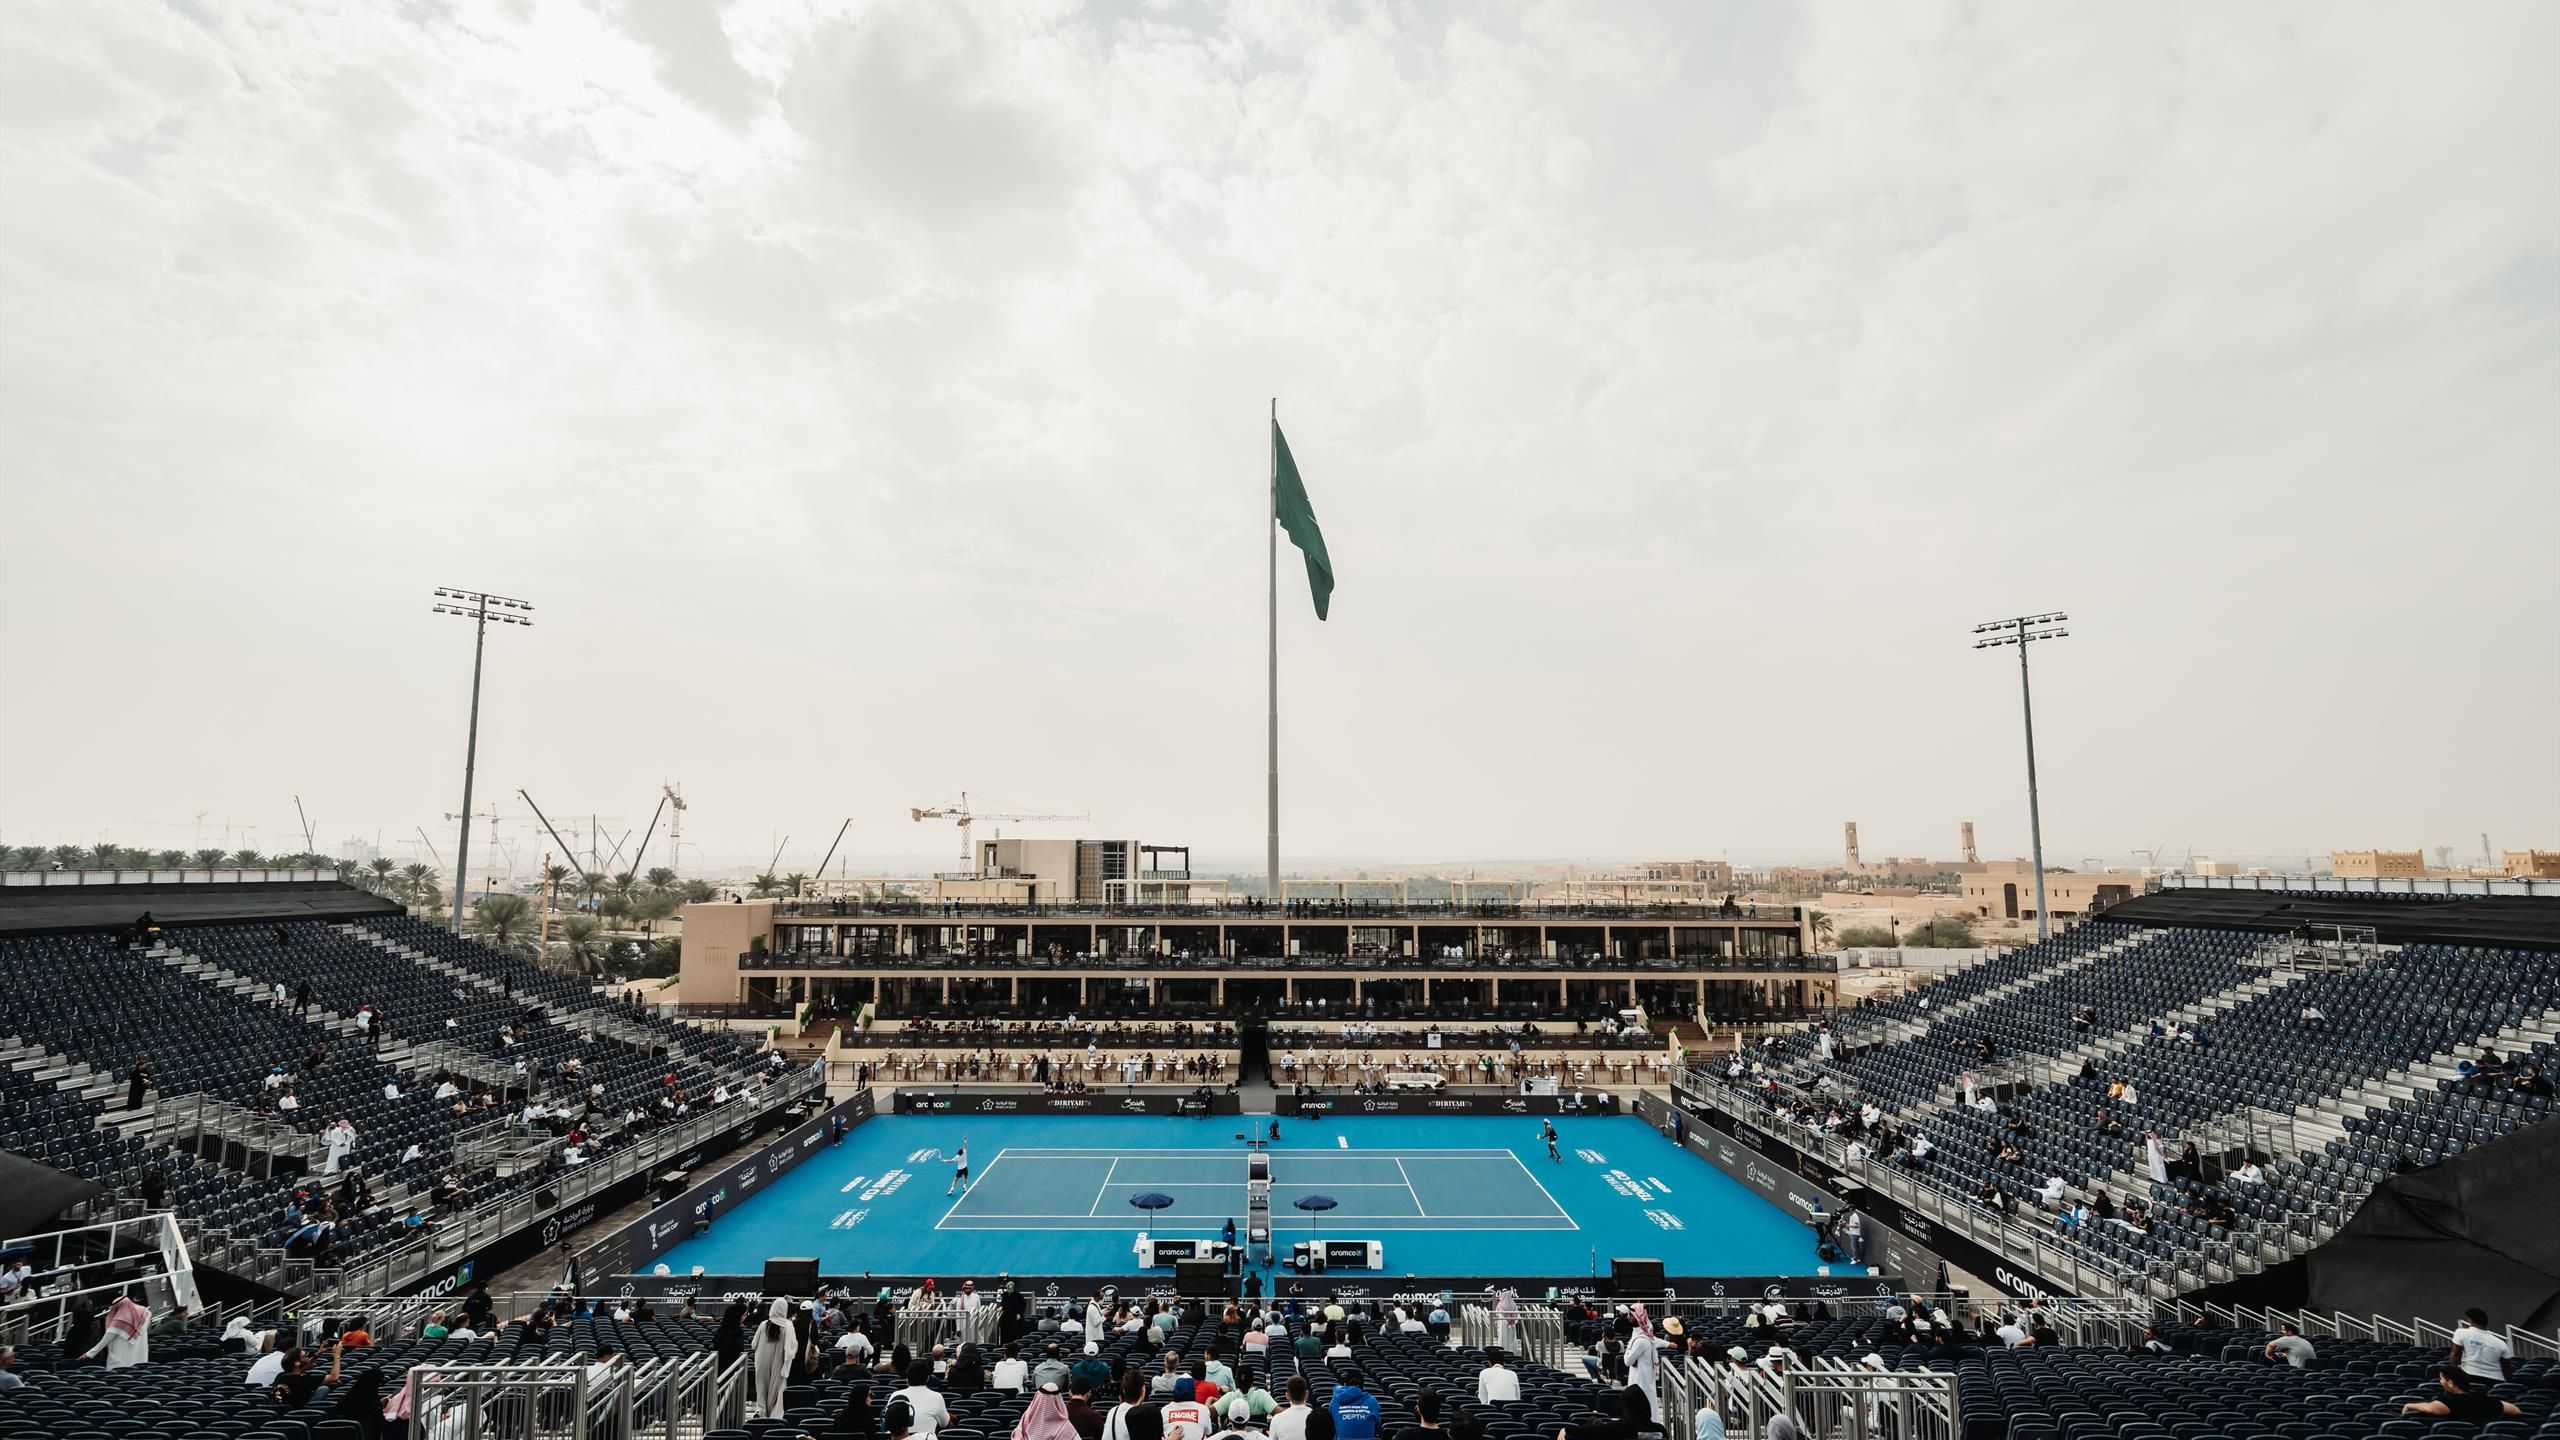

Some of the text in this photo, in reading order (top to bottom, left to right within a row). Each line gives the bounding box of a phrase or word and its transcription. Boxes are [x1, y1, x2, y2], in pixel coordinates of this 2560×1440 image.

[1789, 1191, 1813, 1212] aramco
[1337, 1288, 1364, 1297] الدرعية
[1816, 1287, 1843, 1296] الدرعية
[1170, 1411, 1197, 1421] ENGINE
